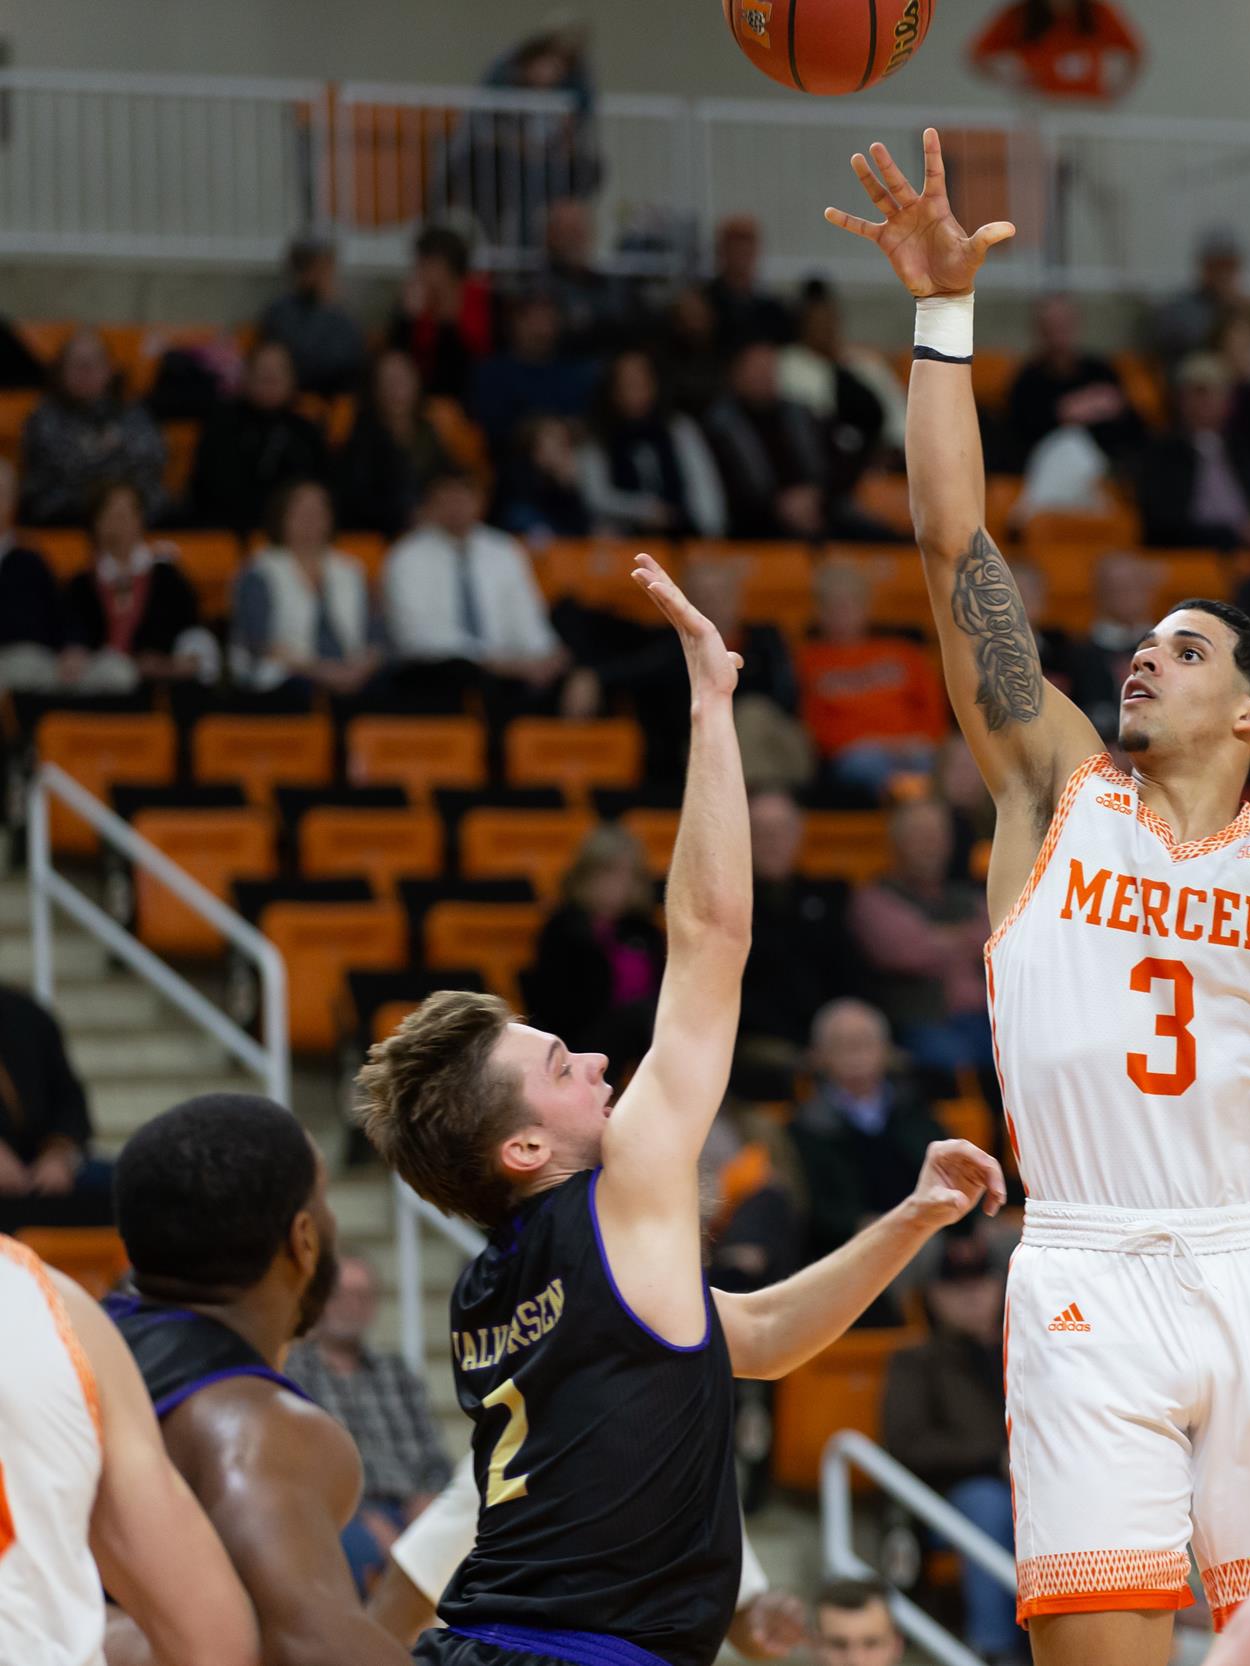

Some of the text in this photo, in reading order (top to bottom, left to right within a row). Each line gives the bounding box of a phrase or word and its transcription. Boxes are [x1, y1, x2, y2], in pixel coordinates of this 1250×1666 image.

[1095, 795, 1133, 815] adidas
[1126, 956, 1197, 1096] 3
[1048, 1319, 1091, 1332] adidas
[482, 1377, 530, 1508] 2
